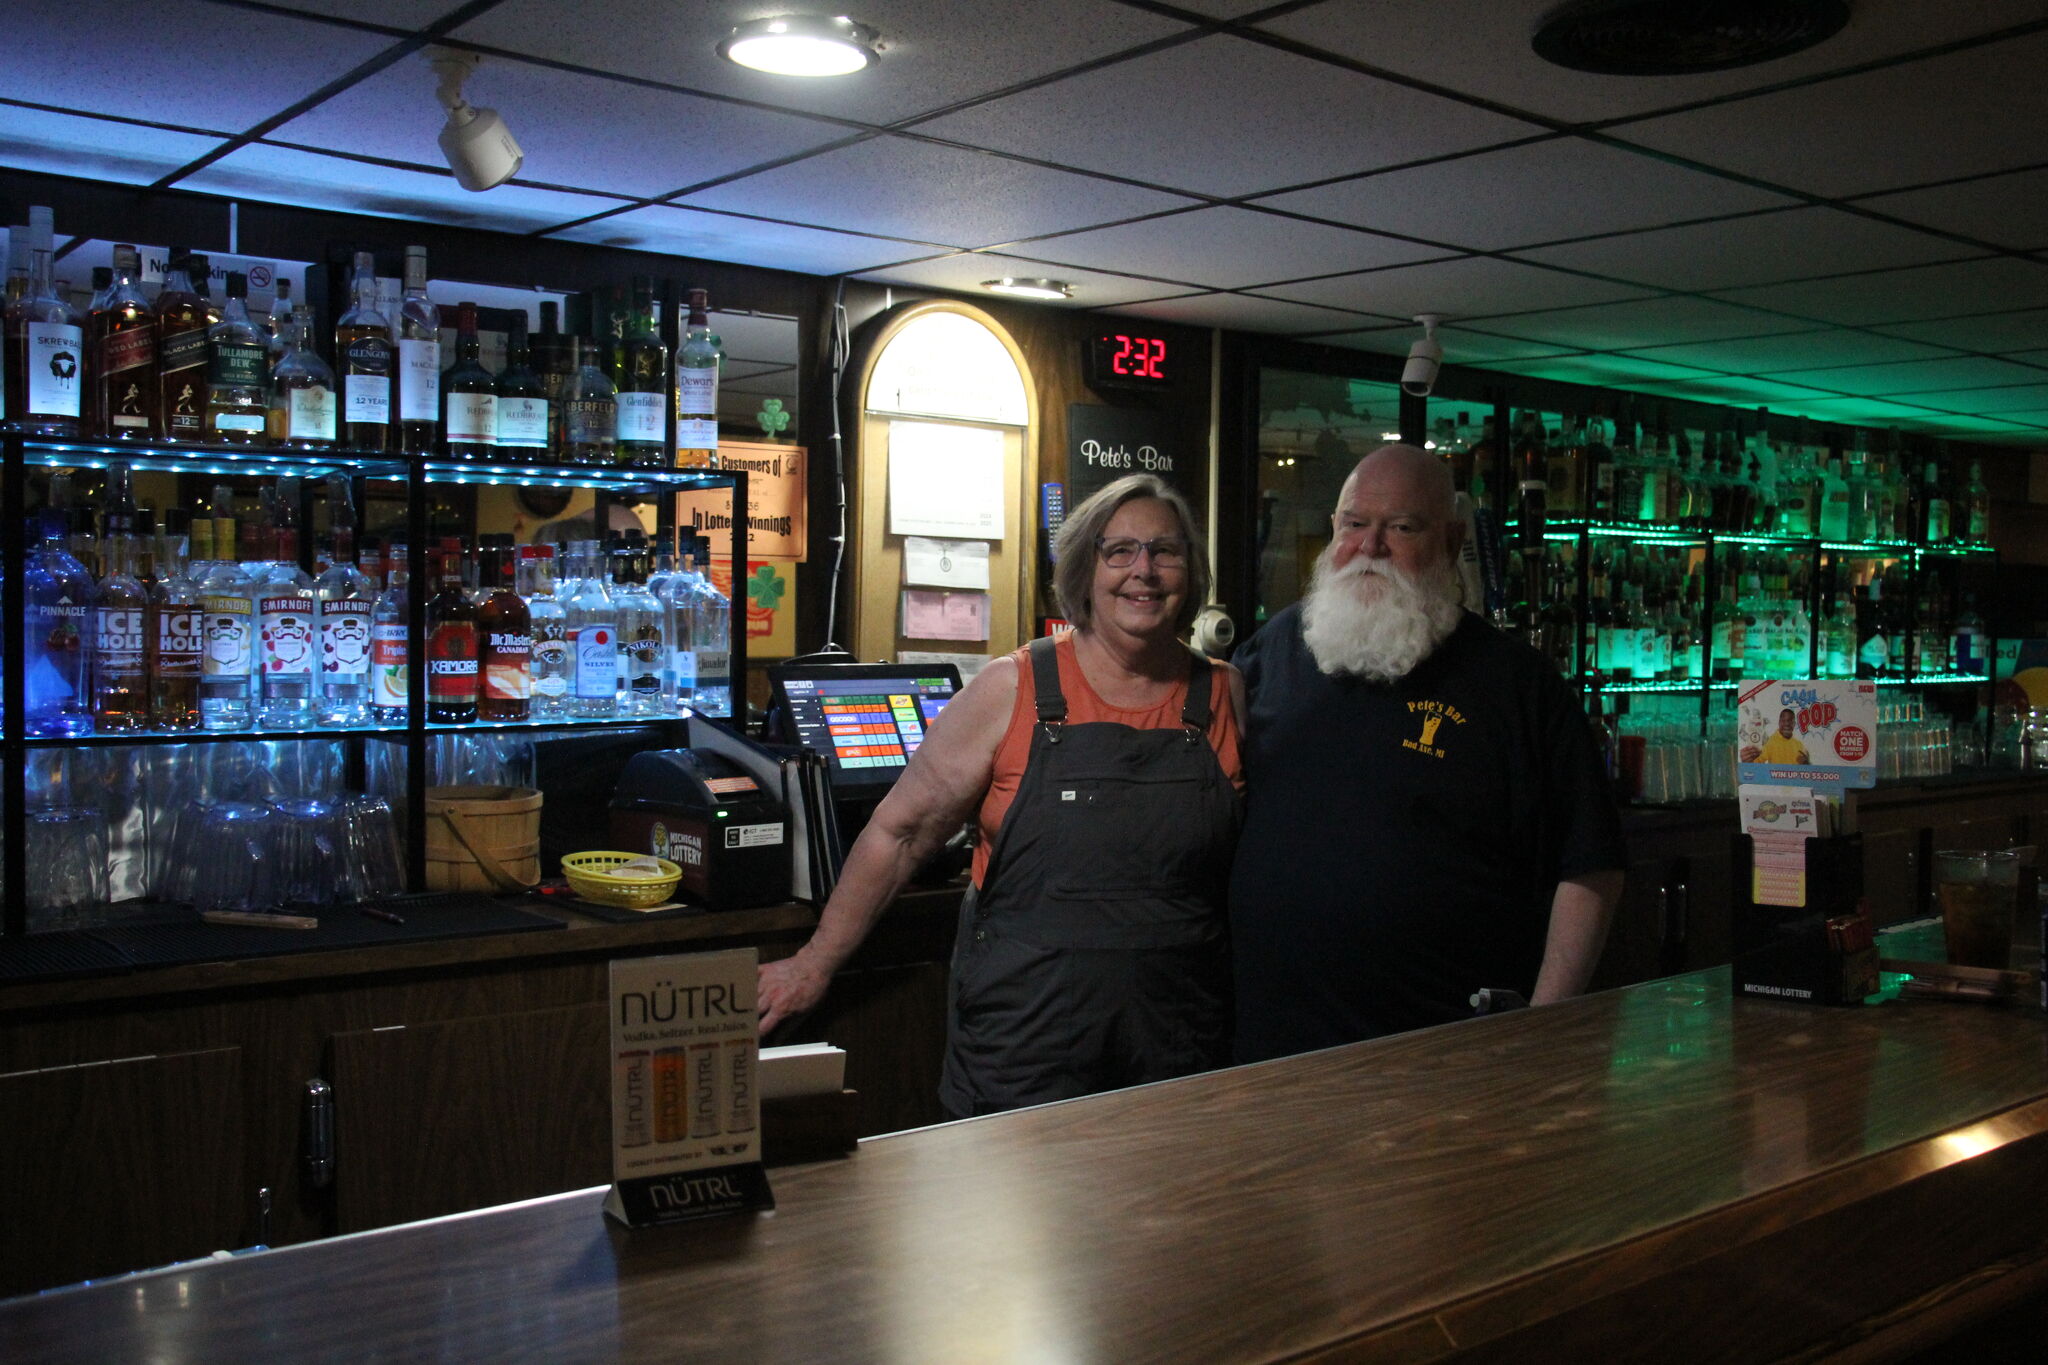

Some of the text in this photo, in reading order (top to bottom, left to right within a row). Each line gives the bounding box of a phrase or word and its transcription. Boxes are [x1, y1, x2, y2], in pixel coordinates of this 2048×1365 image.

[217, 344, 264, 360] TULLAMORE
[1112, 335, 1167, 379] 2:32
[356, 397, 367, 405] 12
[180, 416, 191, 427] 12
[637, 414, 655, 432] 12
[1080, 439, 1174, 472] Pete's Bar
[721, 454, 782, 478] Customers of
[40, 606, 87, 617] PINNACLE
[205, 599, 249, 611] MIRNOFF
[263, 599, 312, 612] SMIRNOFF
[324, 600, 371, 613] SMIRNOFF
[97, 612, 143, 634] ICE
[159, 614, 203, 637] ICE
[97, 635, 143, 650] HOLE
[159, 637, 203, 652] HOLE
[430, 660, 479, 675] KAMORA
[1780, 688, 1817, 707] CASH
[1406, 700, 1468, 726] Pete's Bar
[1797, 702, 1837, 735] POP
[1840, 736, 1864, 747] ONE
[1770, 769, 1787, 779] WIN
[1788, 770, 1798, 779] UP
[1800, 770, 1810, 780] TO
[670, 832, 702, 848] MICHIGAN
[670, 844, 702, 866] LOTTERY
[1744, 983, 1813, 999] MICHIGAN LOTTERY
